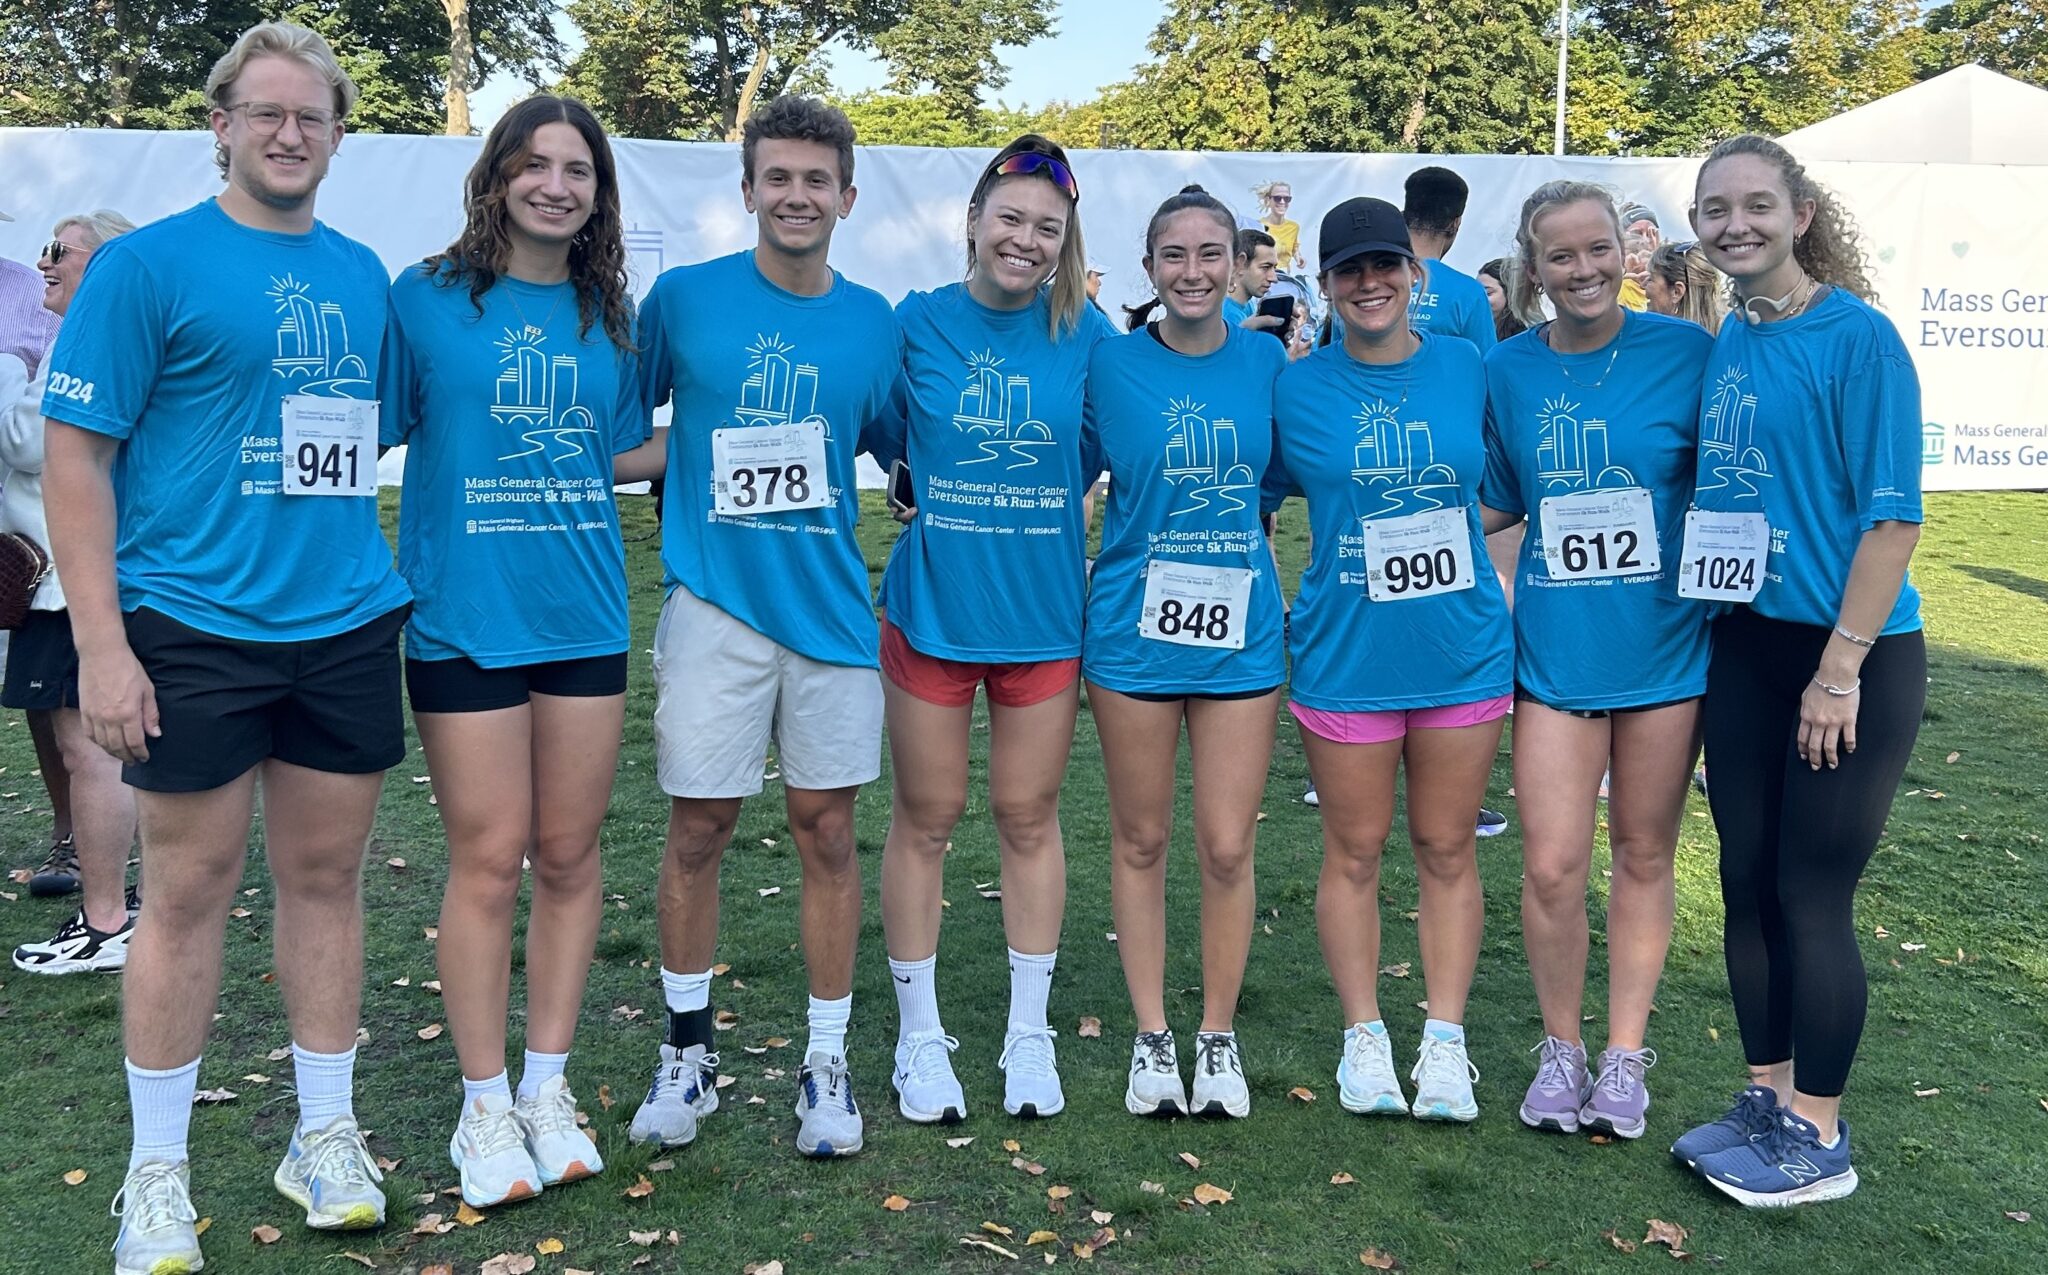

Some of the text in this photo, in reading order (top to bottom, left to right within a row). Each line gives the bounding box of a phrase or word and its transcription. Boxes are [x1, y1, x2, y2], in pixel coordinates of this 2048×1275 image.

[1921, 288, 1994, 312] Mass
[1920, 320, 2048, 348] Eversou
[48, 371, 94, 403] 2024
[1955, 424, 2048, 437] Mass General
[241, 436, 278, 448] Mass
[241, 450, 283, 464] Evers
[297, 442, 358, 488] 941
[1954, 445, 2011, 466] Mass
[465, 477, 497, 489] Mass
[500, 476, 546, 488] General
[547, 477, 584, 489] Cancer
[732, 464, 810, 507] 378
[929, 474, 1069, 497] Mass General Cancer Center
[465, 491, 541, 504] Eversource
[544, 490, 558, 502] 5k
[928, 487, 1066, 509] Eversource 5k Run-Walk
[479, 525, 496, 533] Mass
[497, 524, 524, 532] General
[777, 523, 798, 532] Center
[934, 520, 949, 529] Mass
[950, 523, 974, 532] General
[995, 526, 1015, 534] Center
[1169, 530, 1209, 541] General
[1212, 530, 1247, 541] Cancer
[1207, 541, 1222, 553] 5k
[1561, 530, 1641, 572] 612
[1384, 548, 1457, 594] 990
[1694, 555, 1756, 591] 1024
[1544, 580, 1568, 588] General
[1591, 579, 1614, 587] Center
[1157, 599, 1230, 641] 848
